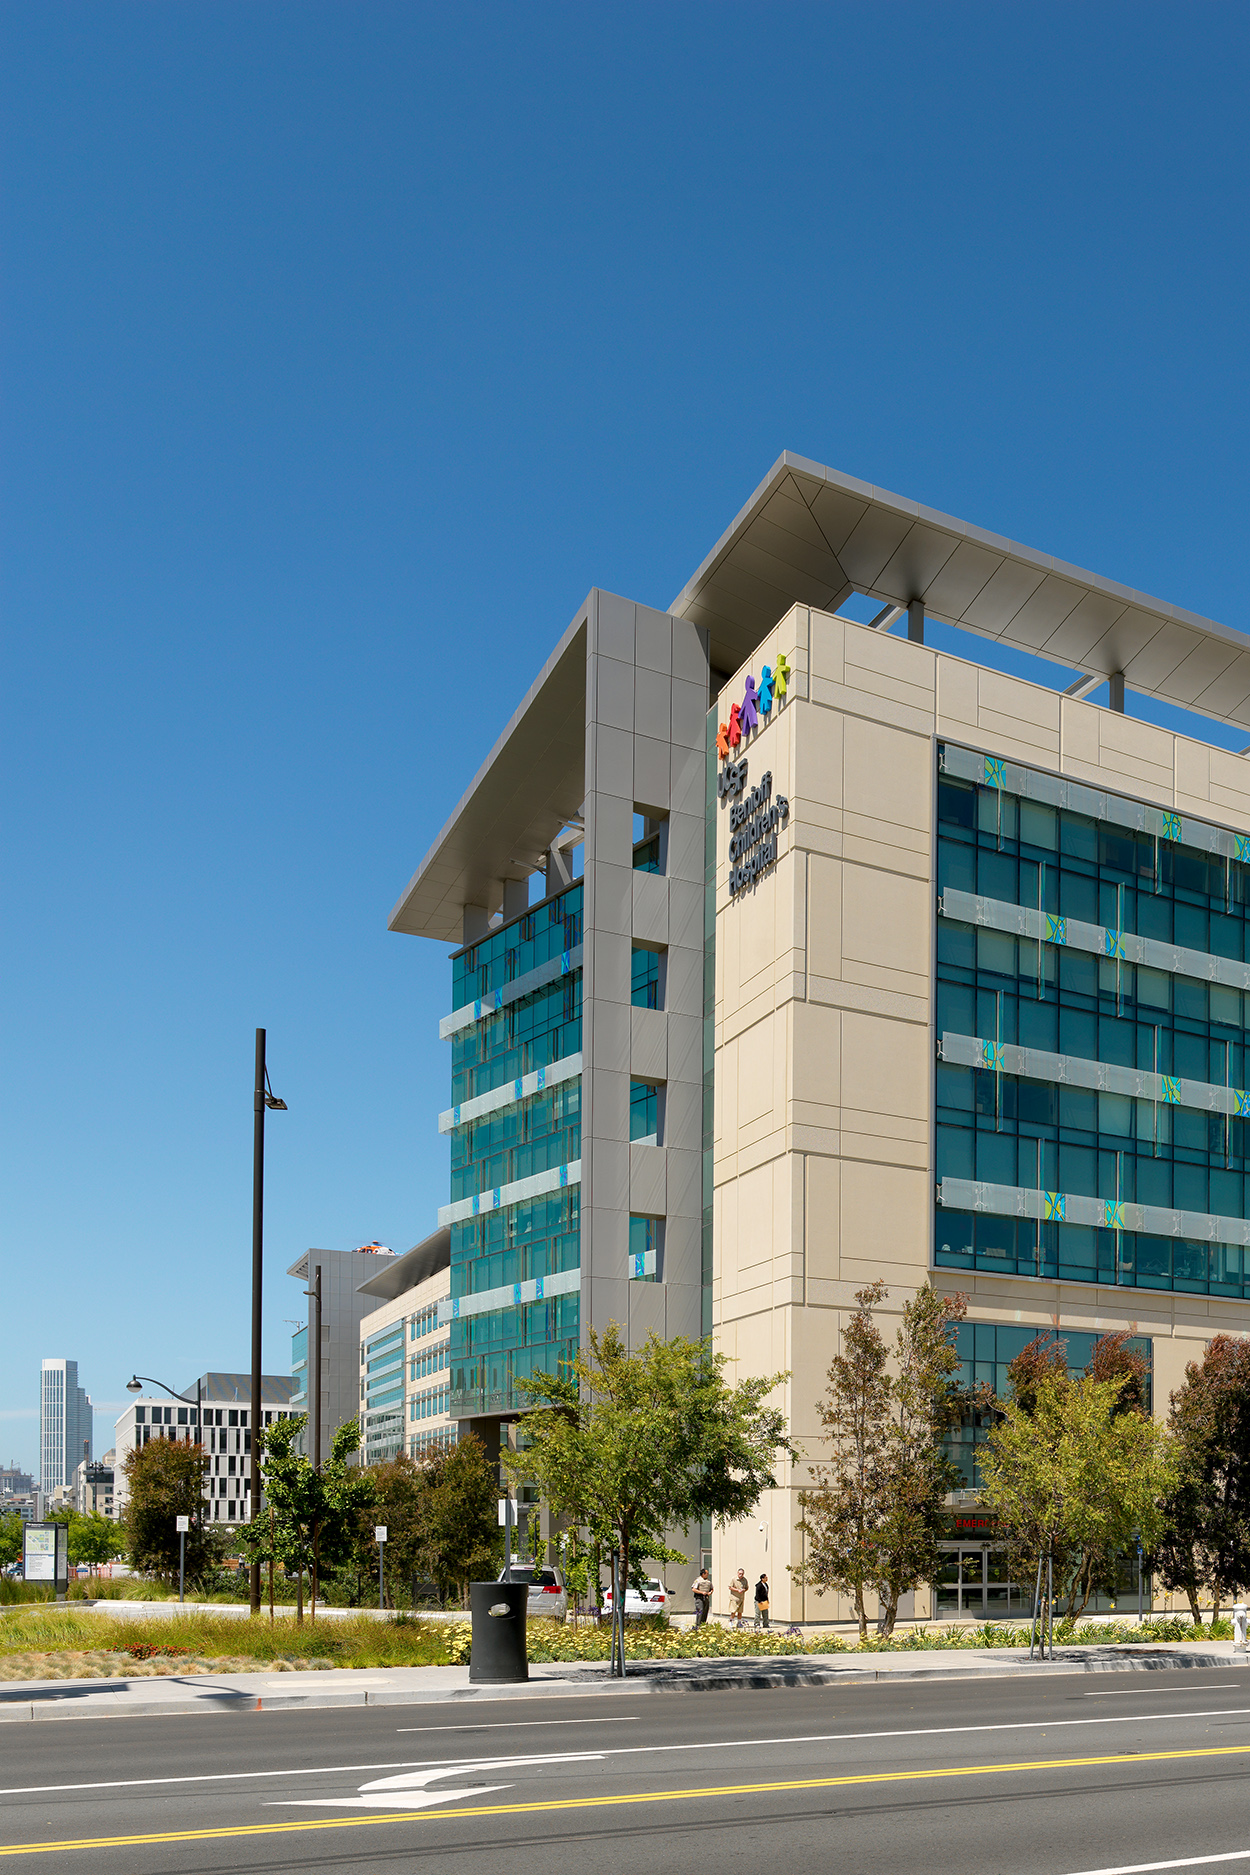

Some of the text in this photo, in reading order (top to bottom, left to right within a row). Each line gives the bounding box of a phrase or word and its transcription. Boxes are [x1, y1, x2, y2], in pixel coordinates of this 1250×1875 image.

[718, 758, 748, 798] UCSF
[730, 770, 772, 833] Benioff
[729, 794, 789, 863] Children's
[729, 832, 777, 896] Hospital
